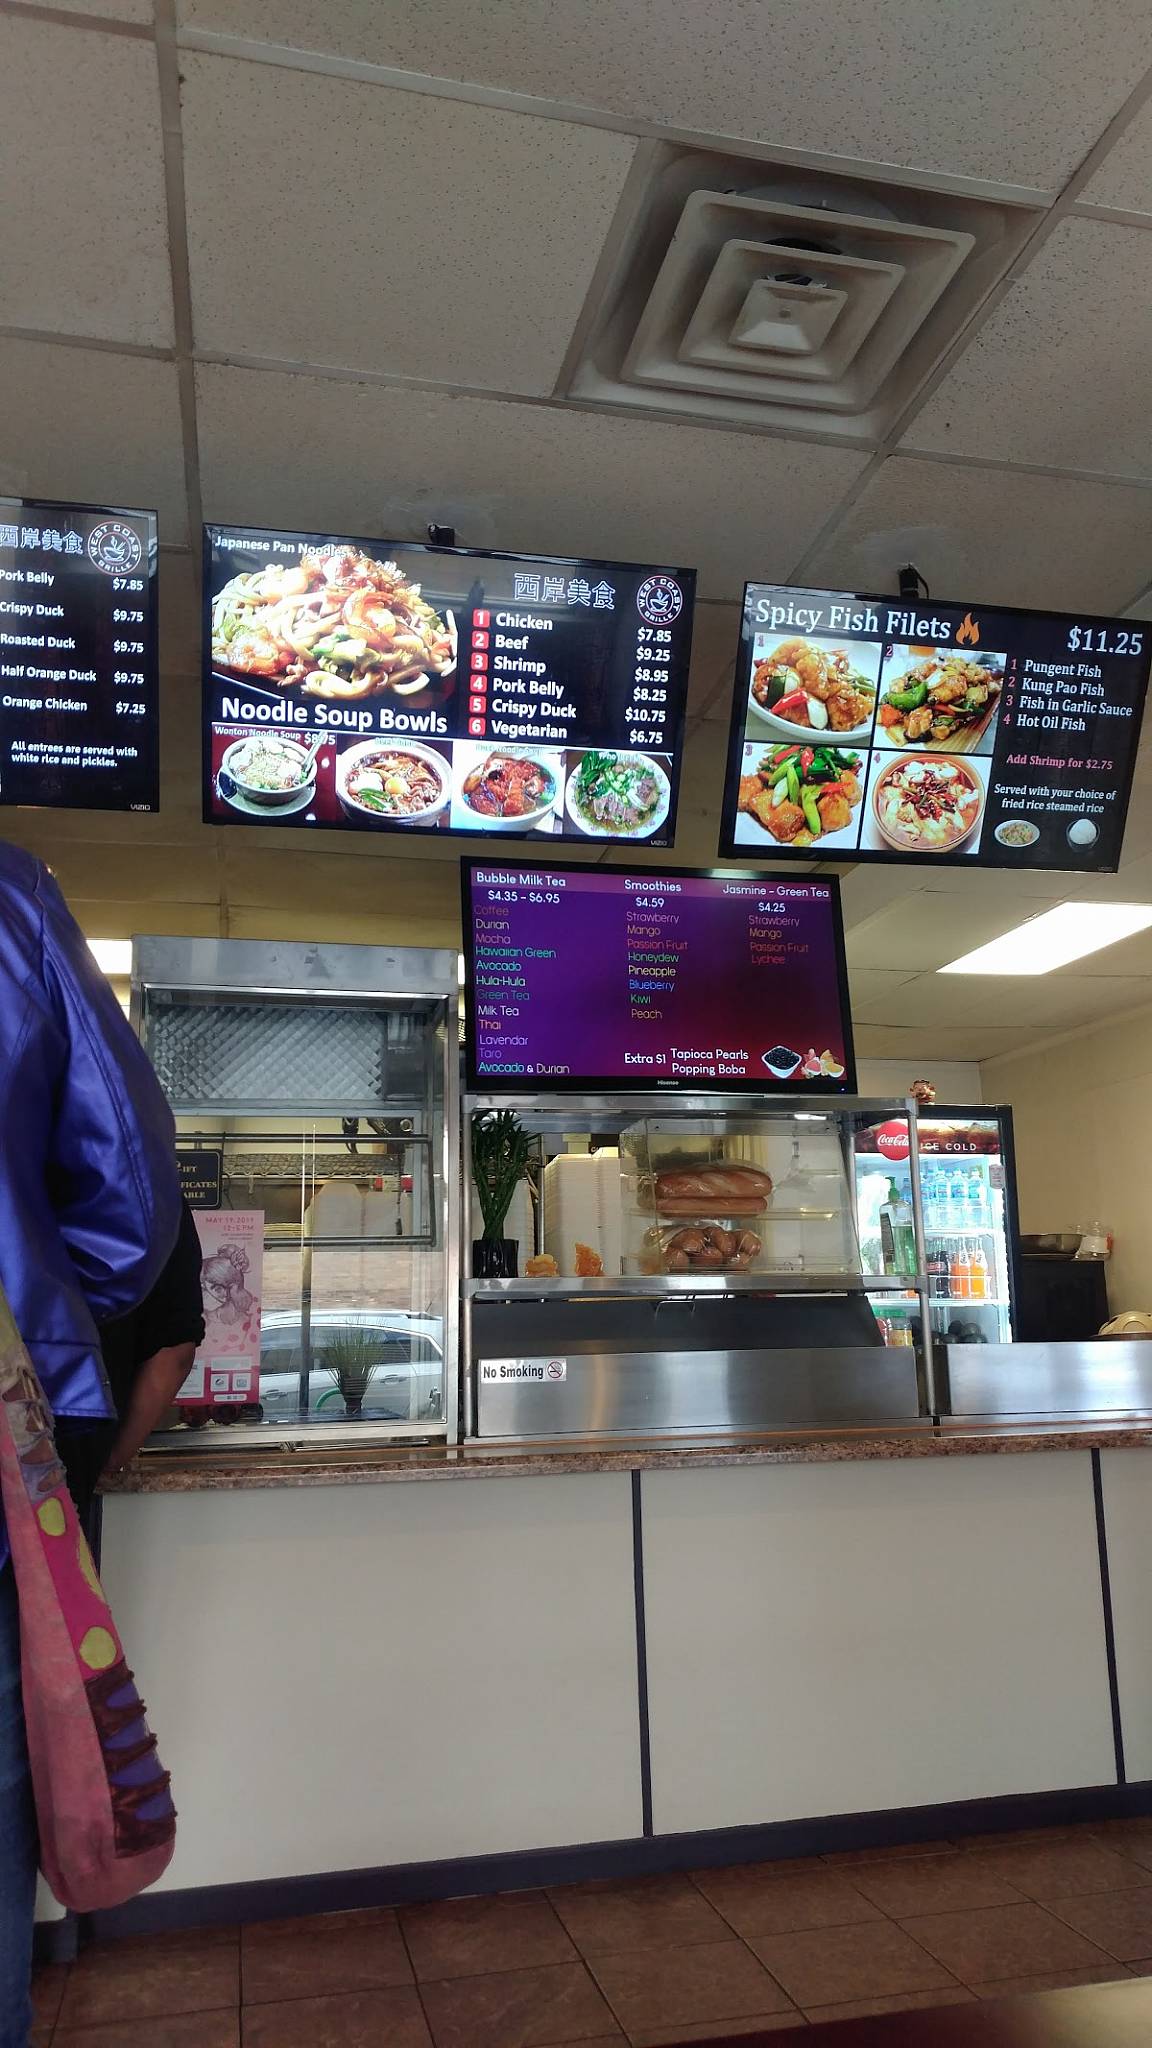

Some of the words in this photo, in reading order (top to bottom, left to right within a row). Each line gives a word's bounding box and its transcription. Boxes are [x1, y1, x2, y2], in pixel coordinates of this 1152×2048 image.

[215, 536, 270, 552] Japanese
[273, 542, 295, 553] Pan
[298, 543, 350, 558] Noodles
[0, 569, 24, 582] Pork
[27, 571, 55, 586] Belly
[113, 577, 144, 590] $7.85
[514, 572, 616, 610] 西岸美食
[0, 602, 34, 616] Crispy
[36, 604, 64, 618] Duck
[113, 608, 144, 622] $9.75
[496, 612, 553, 630] Chicken
[756, 598, 822, 632] Spicy
[829, 606, 878, 632] Fish
[885, 610, 952, 639] Filets
[0, 633, 44, 647] Roasted
[48, 636, 76, 649] Duck
[495, 634, 530, 650] Beef
[637, 627, 672, 643] $7.85
[1067, 626, 1144, 656] $11.25
[113, 640, 144, 654] $9.75
[636, 646, 671, 662] $9.25
[1, 664, 25, 676] Half
[27, 666, 67, 682] Orange
[69, 670, 97, 682] Duck
[494, 656, 547, 676] Shrimp
[1011, 658, 1017, 670] 1
[1024, 660, 1074, 676] Pungent
[1077, 664, 1102, 678] Fish
[114, 670, 145, 684] $9.75
[634, 668, 669, 683] $8.95
[493, 678, 526, 694] Pork
[530, 680, 564, 700] Belly
[634, 686, 667, 702] $8.25
[1008, 677, 1016, 688] 2
[1022, 678, 1054, 694] Kung
[1056, 680, 1078, 694] Pao
[1080, 682, 1105, 697] Fish
[2, 695, 42, 710] Orange
[45, 698, 88, 712] Chicken
[116, 701, 146, 716] $7.25
[492, 699, 537, 718] Crispy
[541, 702, 577, 718] Duck
[1006, 694, 1014, 706] 3
[1019, 696, 1045, 710] Fish
[1048, 698, 1059, 711] in
[1062, 699, 1096, 714] Garlic
[1099, 702, 1132, 716] Sauce
[222, 698, 308, 724] Noodle
[314, 704, 373, 732] Soup
[380, 708, 448, 733] Bowls
[625, 707, 666, 722] $10.75
[1003, 714, 1010, 725] 4
[1017, 714, 1040, 728] Hot
[1042, 716, 1058, 729] Oil
[1061, 717, 1086, 730] Fish
[214, 726, 248, 736] Wonton
[280, 730, 302, 741] Soup
[492, 720, 568, 739] Vegetarian
[630, 730, 663, 744] $6.75
[12, 741, 26, 751] All
[28, 742, 64, 752] entrees
[66, 745, 81, 754] are
[83, 746, 114, 756] served
[116, 747, 138, 758] with
[12, 753, 39, 764] white
[42, 754, 60, 764] rice
[62, 756, 80, 765] and
[82, 756, 118, 768] pickles.
[1006, 754, 1026, 764] Add
[1030, 756, 1066, 768] Shrimp
[1067, 758, 1084, 768] for
[1086, 759, 1114, 770] $2.75
[994, 784, 1026, 795] Served
[1028, 786, 1050, 796] with
[1050, 788, 1074, 799] your
[1074, 788, 1104, 800] choice
[1106, 790, 1118, 800] of
[1002, 798, 1024, 809] fried
[1026, 800, 1044, 810] rice
[1046, 801, 1084, 812] steamed
[1086, 803, 1104, 813] rice
[476, 872, 517, 884] Bubble
[519, 873, 543, 886] Milk
[545, 876, 566, 888] Tea
[625, 879, 682, 892] Smoothies
[488, 890, 518, 902] $4.35
[529, 891, 560, 904] $6.95
[723, 885, 767, 896] Jasmine
[777, 886, 808, 898] Green
[810, 887, 830, 898] Tea
[636, 897, 664, 908] $4.59
[758, 902, 786, 913] $4.25
[474, 904, 510, 916] Coffee
[475, 919, 510, 930] Durian
[626, 912, 680, 924] Strawberry
[748, 915, 800, 927] Strawberry
[627, 924, 661, 937] Mango
[750, 928, 782, 940] Mango
[475, 933, 511, 944] Mocha
[627, 939, 664, 950] Passion
[666, 940, 688, 950] Fruit
[524, 948, 556, 959] Green
[750, 942, 786, 952] Passion
[788, 943, 808, 953] Fruit
[628, 952, 680, 964] Honeydew
[752, 954, 785, 966] Lychee
[476, 960, 522, 972] Avocado
[628, 965, 676, 978] Pineapple
[476, 976, 526, 987] Hula-Hula
[629, 979, 674, 992] Blueberry
[476, 990, 508, 1000] Green
[512, 990, 530, 1001] Tea
[630, 994, 651, 1004] Kiwi
[478, 1005, 498, 1016] Milk
[500, 1006, 520, 1017] Tea
[631, 1008, 663, 1020] Peach
[479, 1020, 502, 1030] Thai
[479, 1034, 528, 1046] Lavendar
[479, 1048, 502, 1059] Taro
[625, 1053, 653, 1064] Extra
[656, 1054, 666, 1064] $1
[670, 1048, 713, 1061] Tapioca
[716, 1049, 749, 1060] Pearls
[478, 1062, 525, 1073] Avocado
[526, 1064, 534, 1073] &
[536, 1063, 570, 1074] Durian
[672, 1063, 716, 1076] Popping
[719, 1064, 746, 1074] Boba
[920, 1142, 940, 1150] ICE
[946, 1143, 976, 1151] COLD
[180, 1181, 217, 1189] FICATES
[484, 1366, 496, 1378] No
[500, 1365, 544, 1380] Smoking
